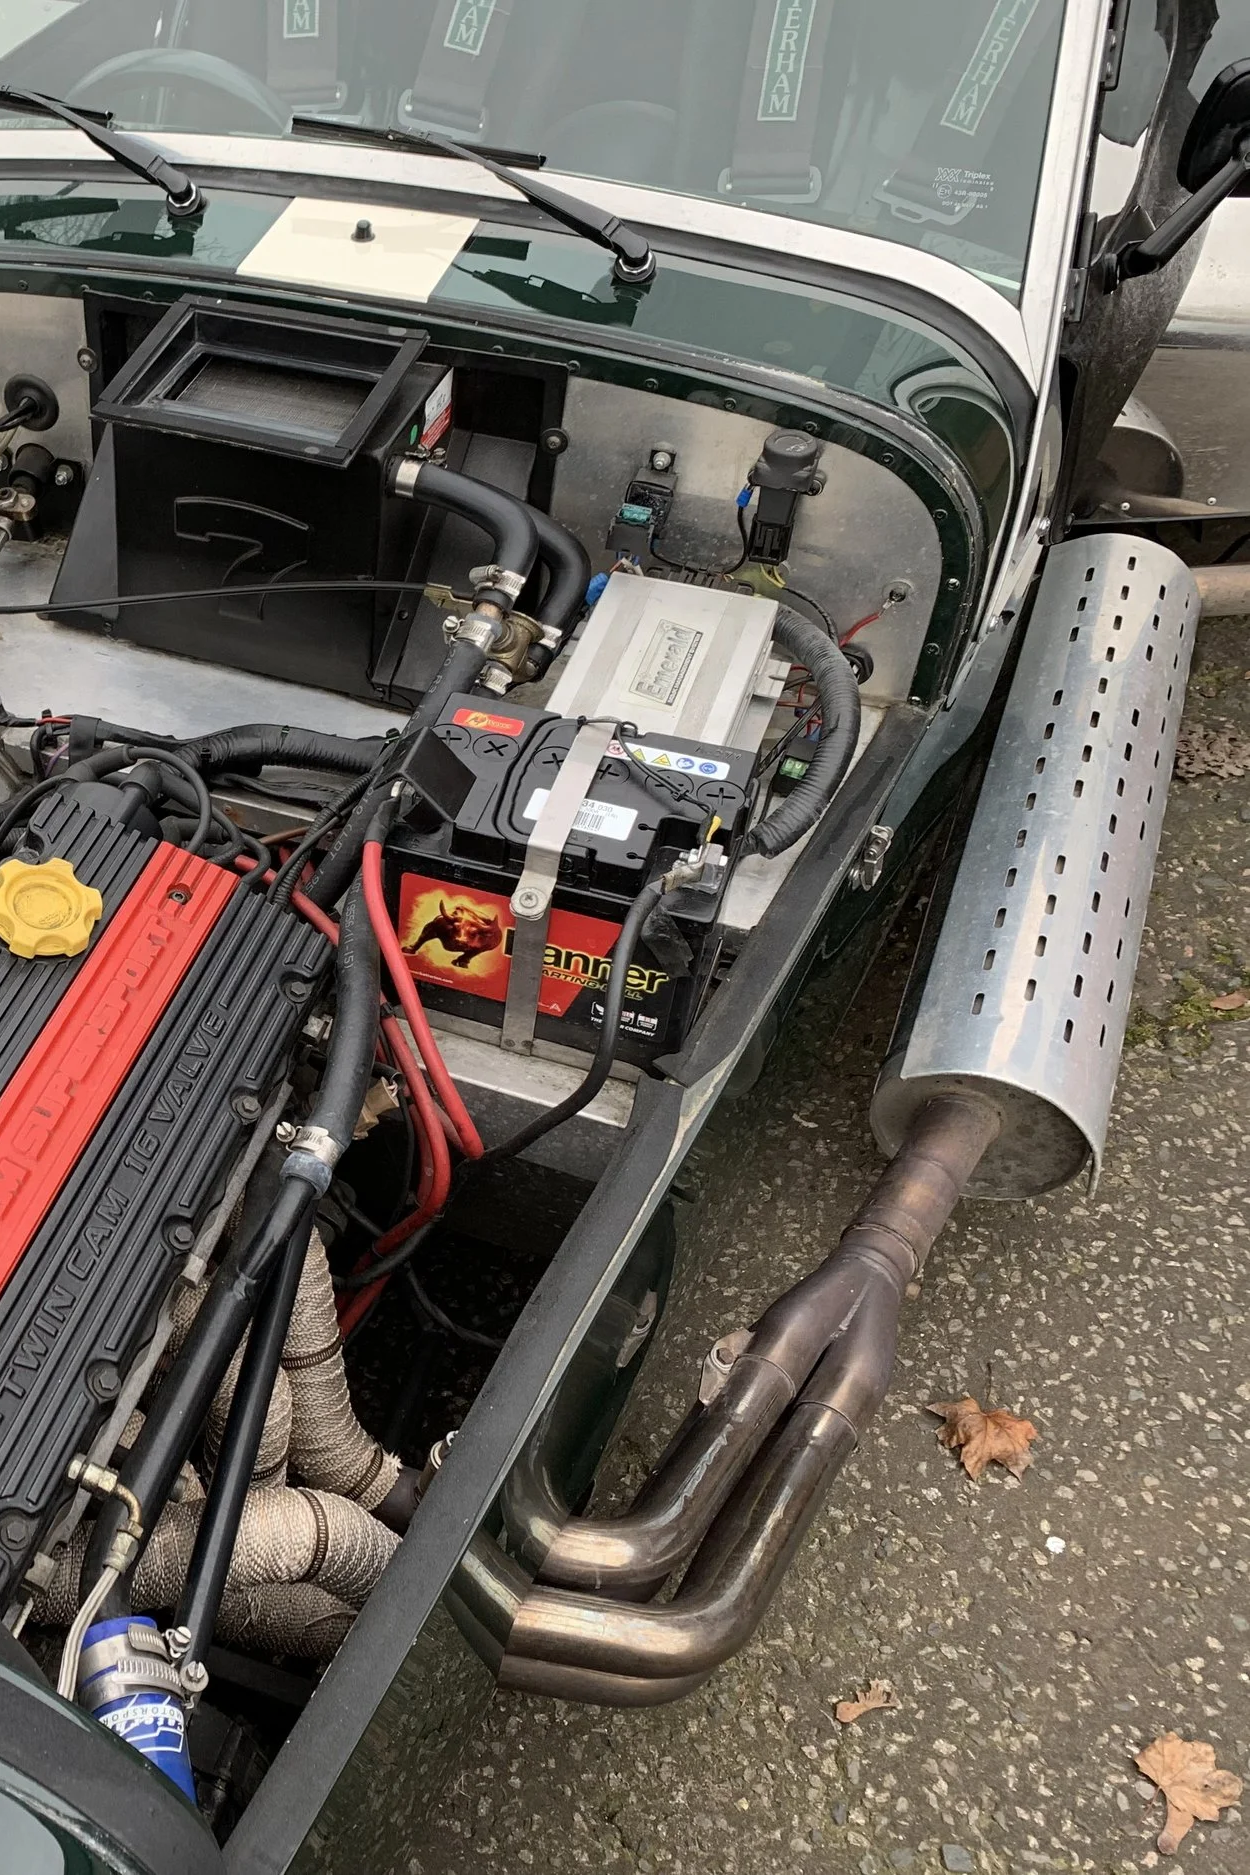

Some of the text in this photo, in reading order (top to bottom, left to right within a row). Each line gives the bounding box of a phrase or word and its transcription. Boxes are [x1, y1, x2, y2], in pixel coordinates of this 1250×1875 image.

[964, 170, 991, 180] Triplex
[68, 1184, 130, 1286] CAM
[123, 1128, 161, 1175] 16
[148, 1010, 227, 1124] VALVE
[103, 1706, 183, 1726] MOTORSPOR
